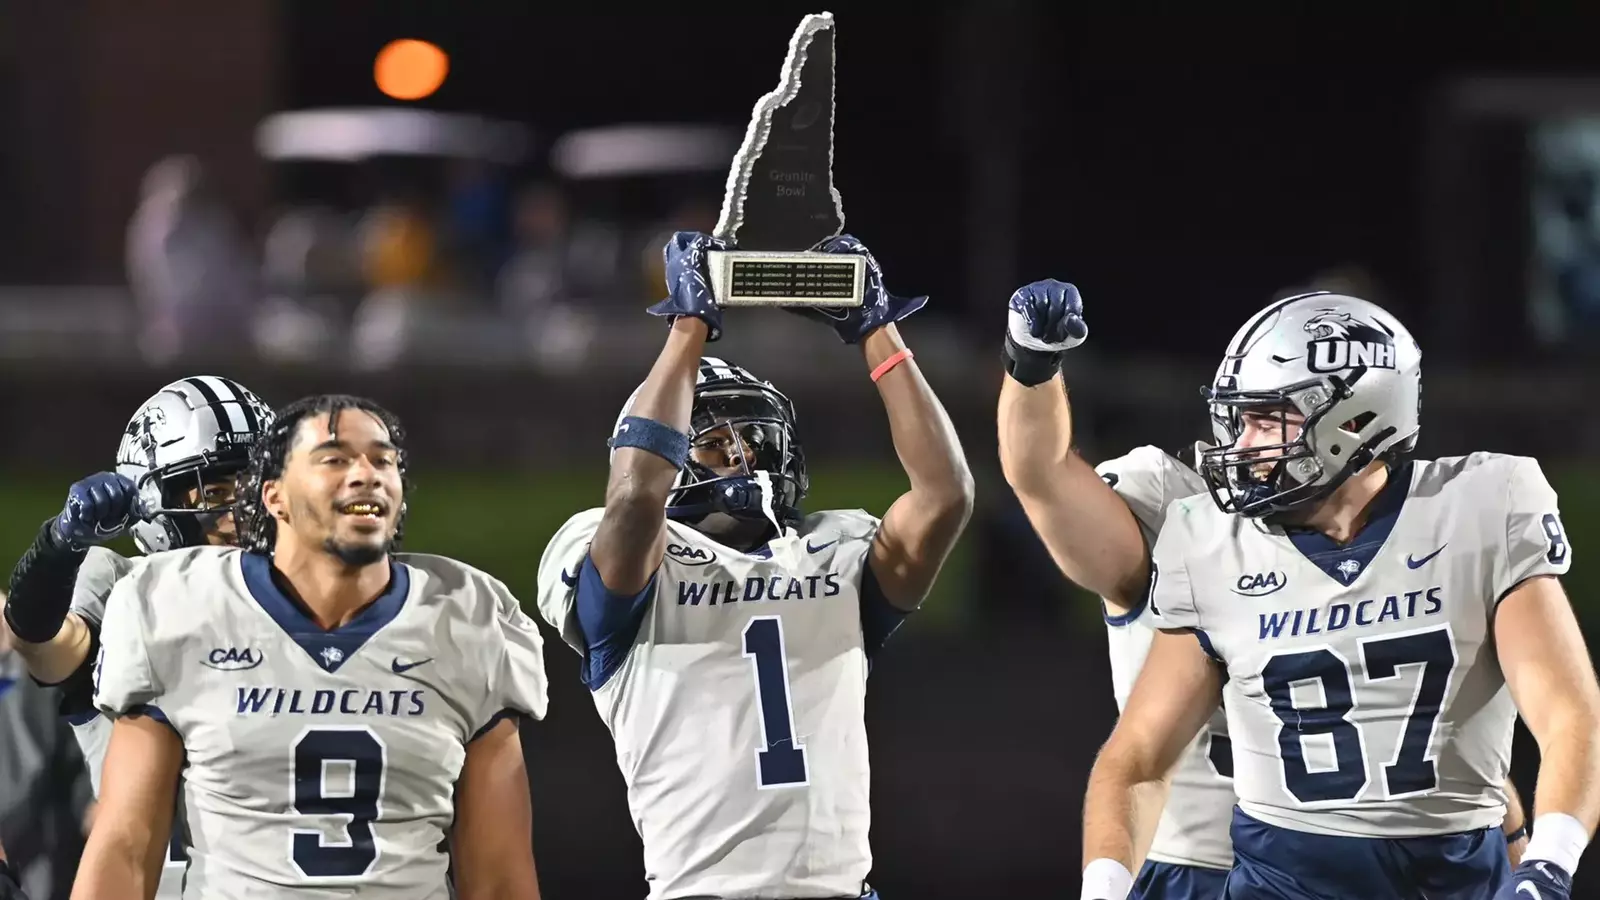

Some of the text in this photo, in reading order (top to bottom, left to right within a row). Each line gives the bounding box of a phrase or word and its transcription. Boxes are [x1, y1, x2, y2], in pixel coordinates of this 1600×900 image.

[776, 184, 806, 197] Bowl
[1308, 339, 1396, 372] UNH
[666, 543, 708, 561] CAA
[677, 572, 841, 606] WILDCATS
[1237, 571, 1279, 591] CAA
[1258, 586, 1443, 640] WILDCATS
[208, 647, 254, 664] CAA
[236, 687, 426, 716] WILDCATS
[742, 615, 810, 790] 1
[1260, 625, 1457, 803] 87
[290, 725, 384, 878] 9
